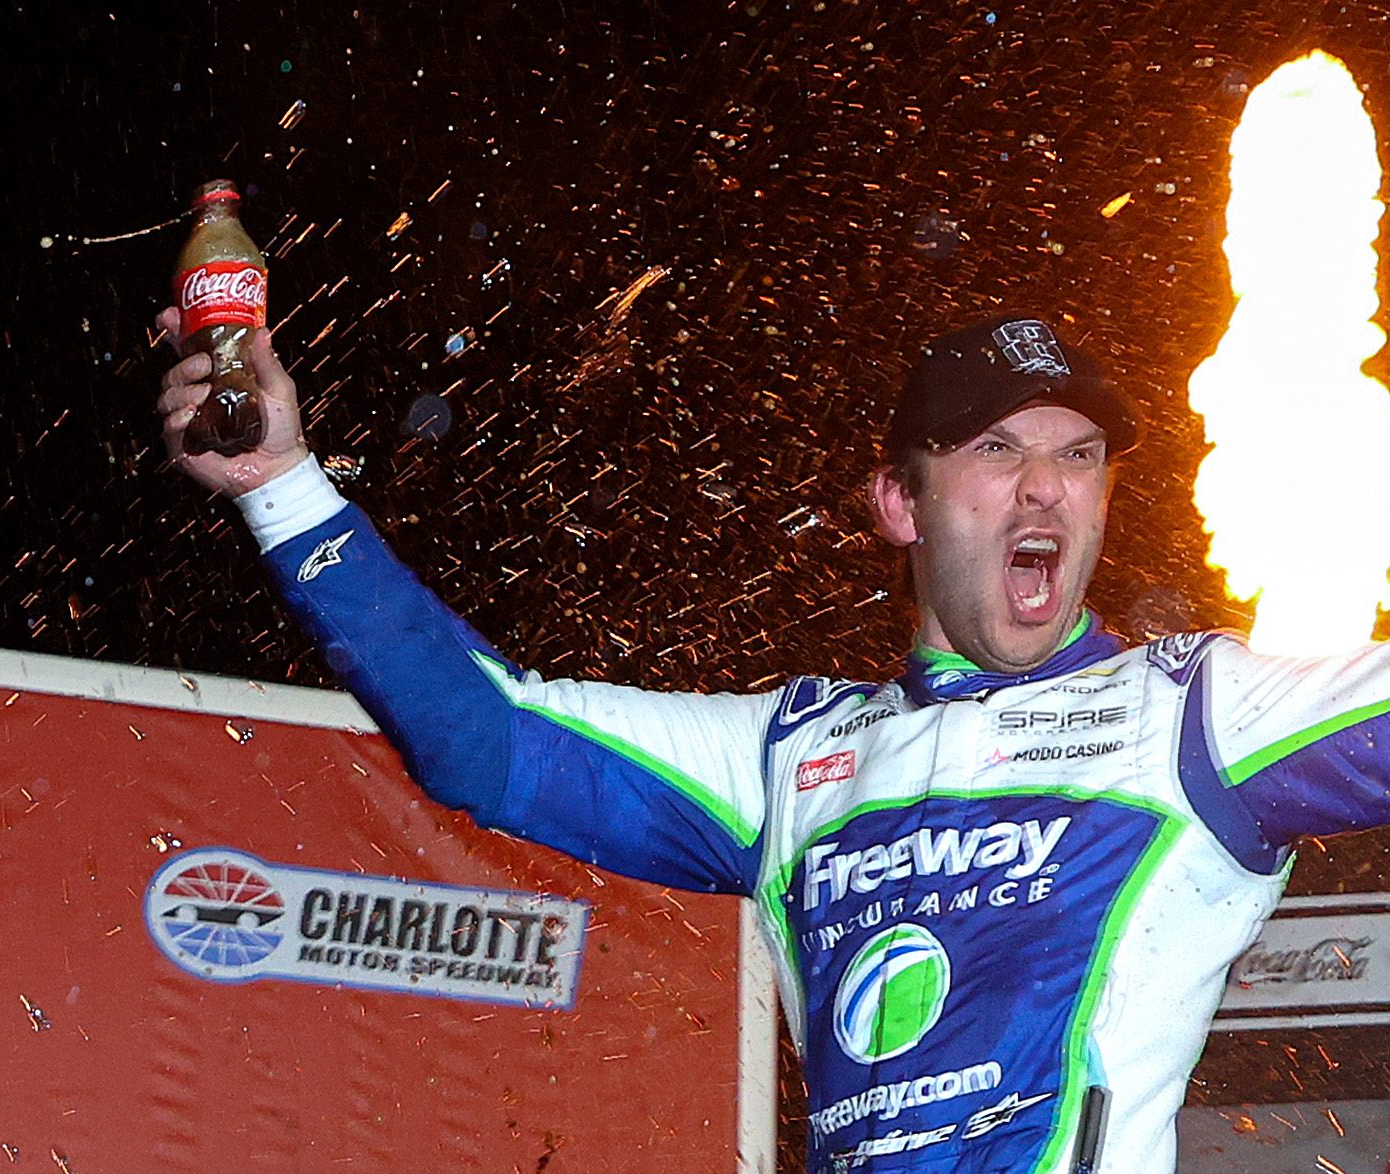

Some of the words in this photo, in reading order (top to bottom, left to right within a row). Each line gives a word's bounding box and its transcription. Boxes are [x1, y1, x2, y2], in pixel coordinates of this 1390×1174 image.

[1013, 747, 1062, 762] MODO
[1065, 740, 1125, 759] CASINO
[803, 816, 1072, 912] Freeway
[299, 888, 568, 966] CHARLOTTE
[298, 944, 404, 971] MOTOR
[406, 955, 561, 990] SPEEDWAY
